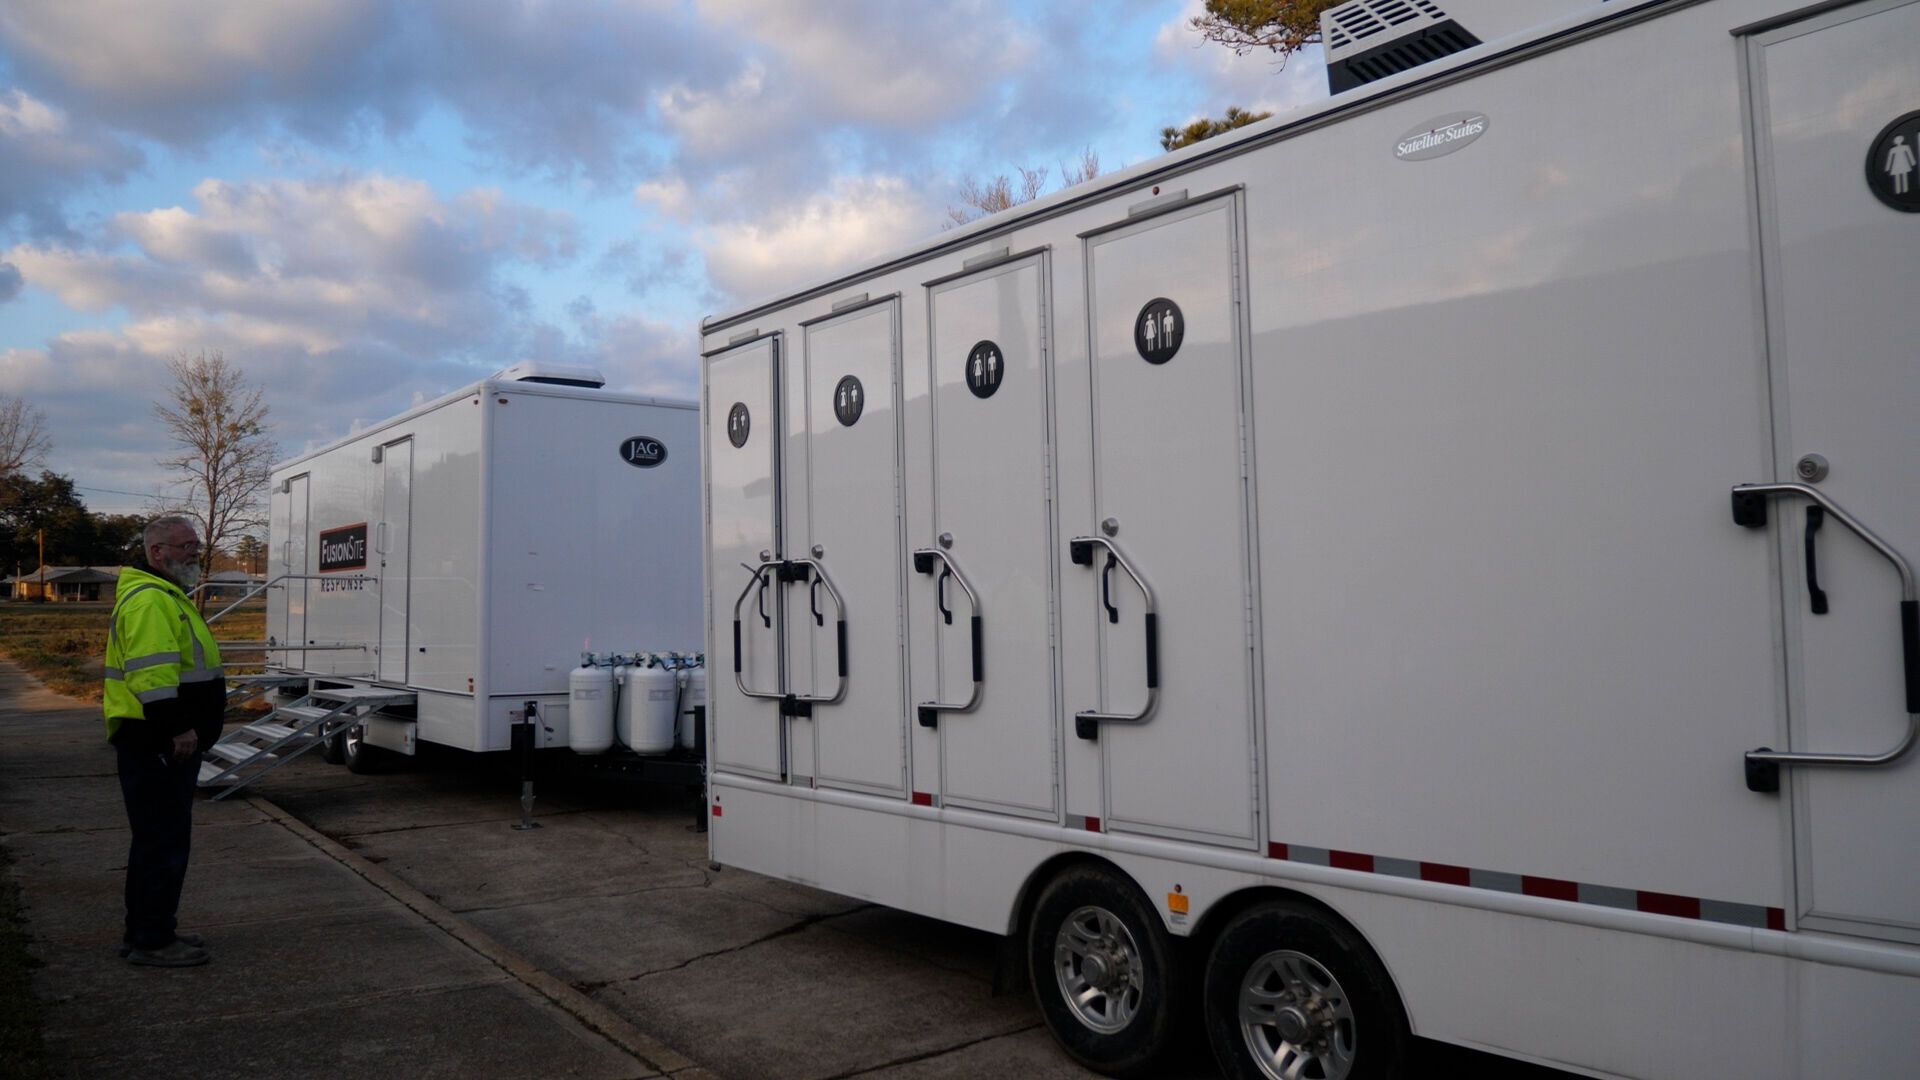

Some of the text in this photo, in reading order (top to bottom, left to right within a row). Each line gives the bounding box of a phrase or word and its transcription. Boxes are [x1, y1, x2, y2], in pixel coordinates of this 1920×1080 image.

[1397, 120, 1483, 157] Satellite Suites
[629, 441, 658, 461] JAG
[321, 574, 364, 592] RESPONSE
